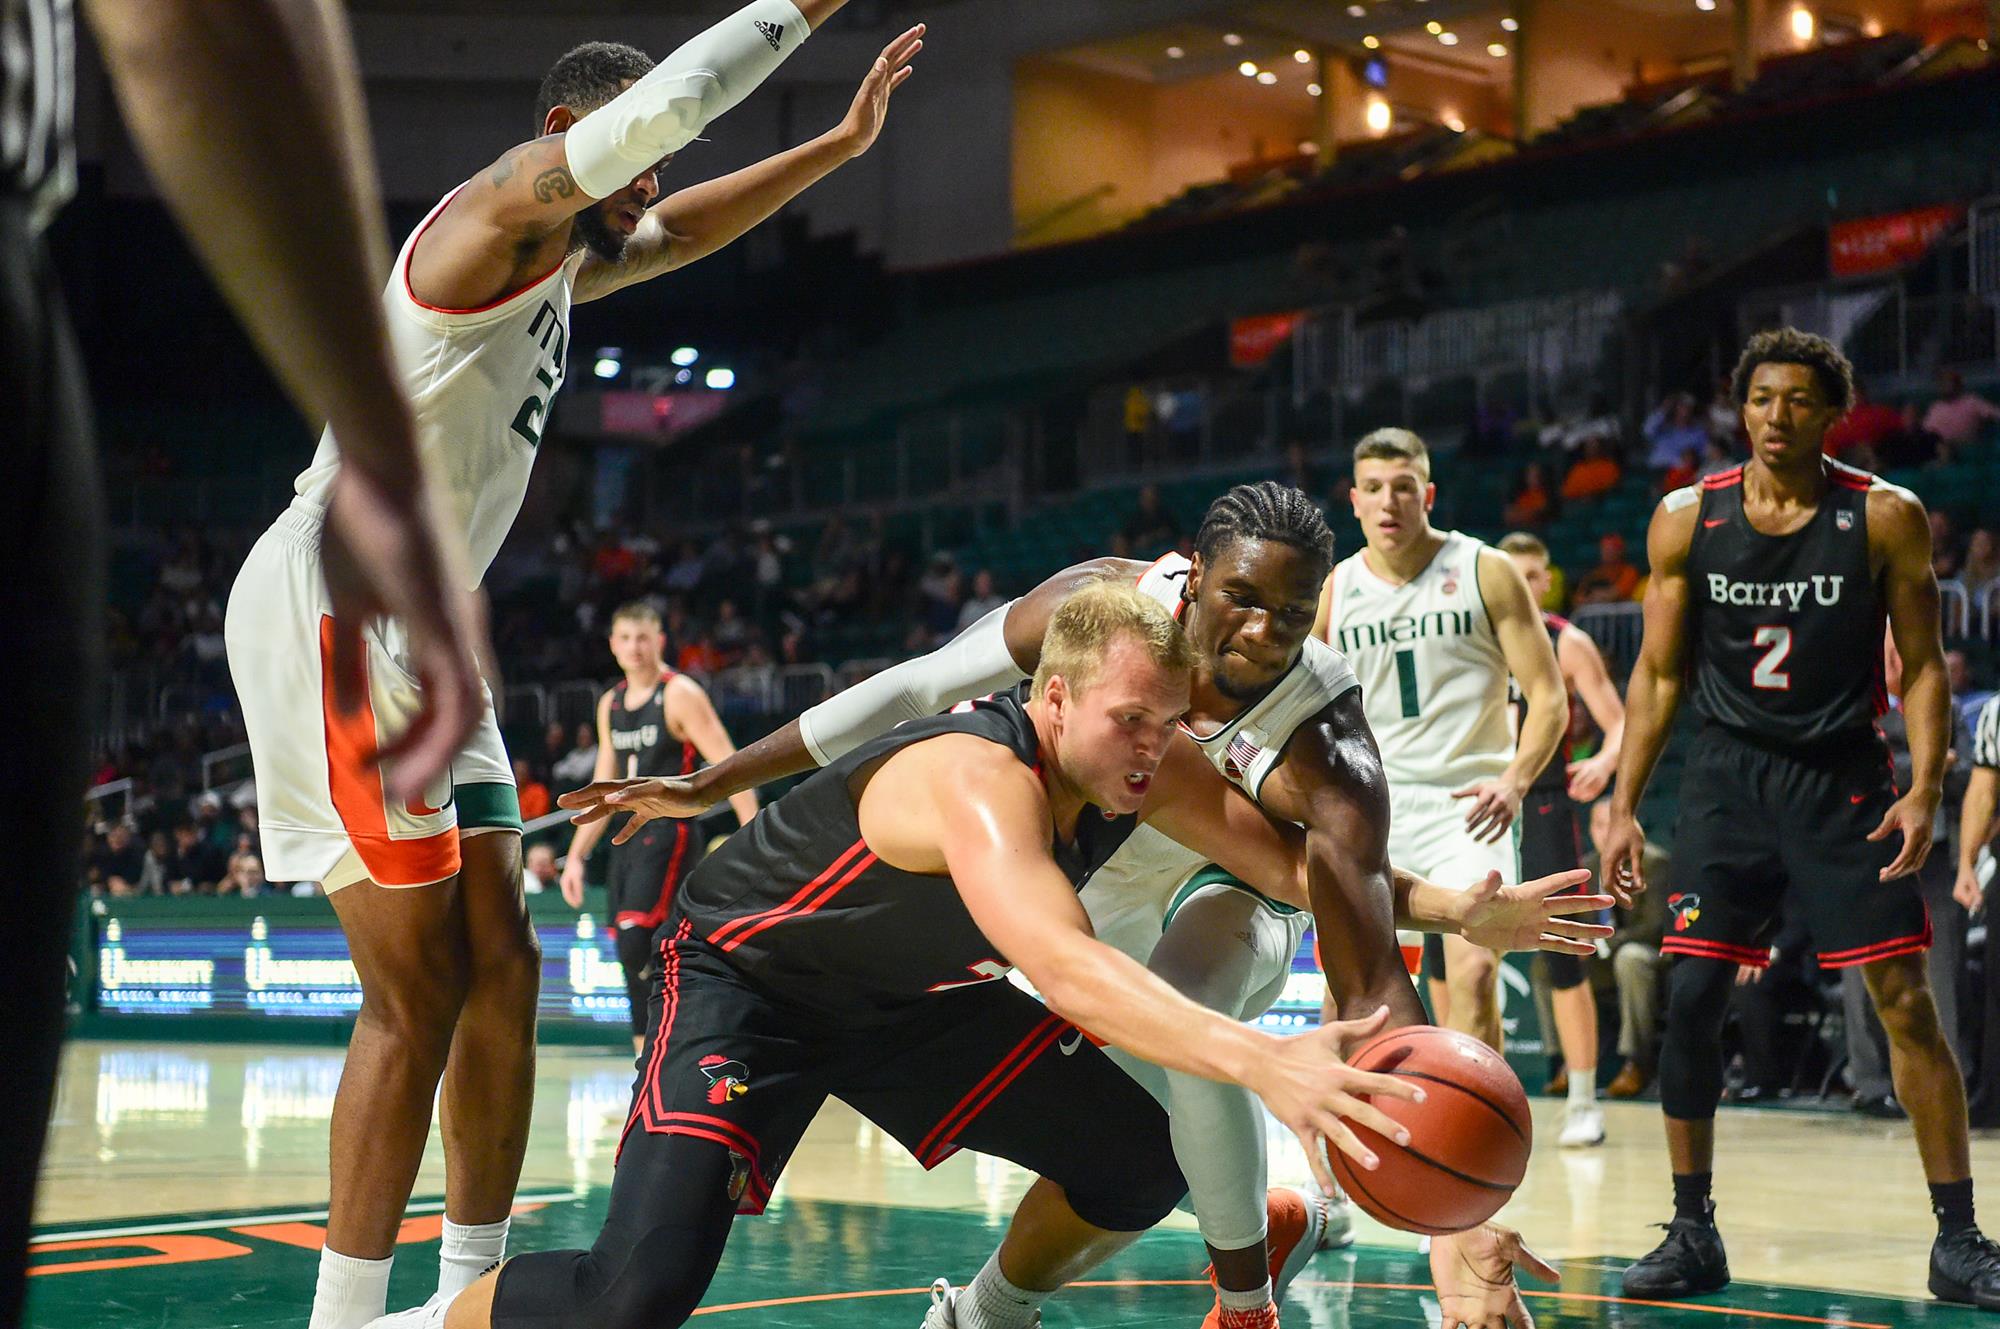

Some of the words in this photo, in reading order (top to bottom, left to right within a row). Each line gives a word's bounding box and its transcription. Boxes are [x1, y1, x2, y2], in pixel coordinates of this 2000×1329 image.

[754, 21, 780, 51] adidas
[1707, 573, 1808, 612] Barry
[1811, 575, 1844, 606] U
[1752, 626, 1791, 690] 2
[1395, 650, 1420, 718] 1
